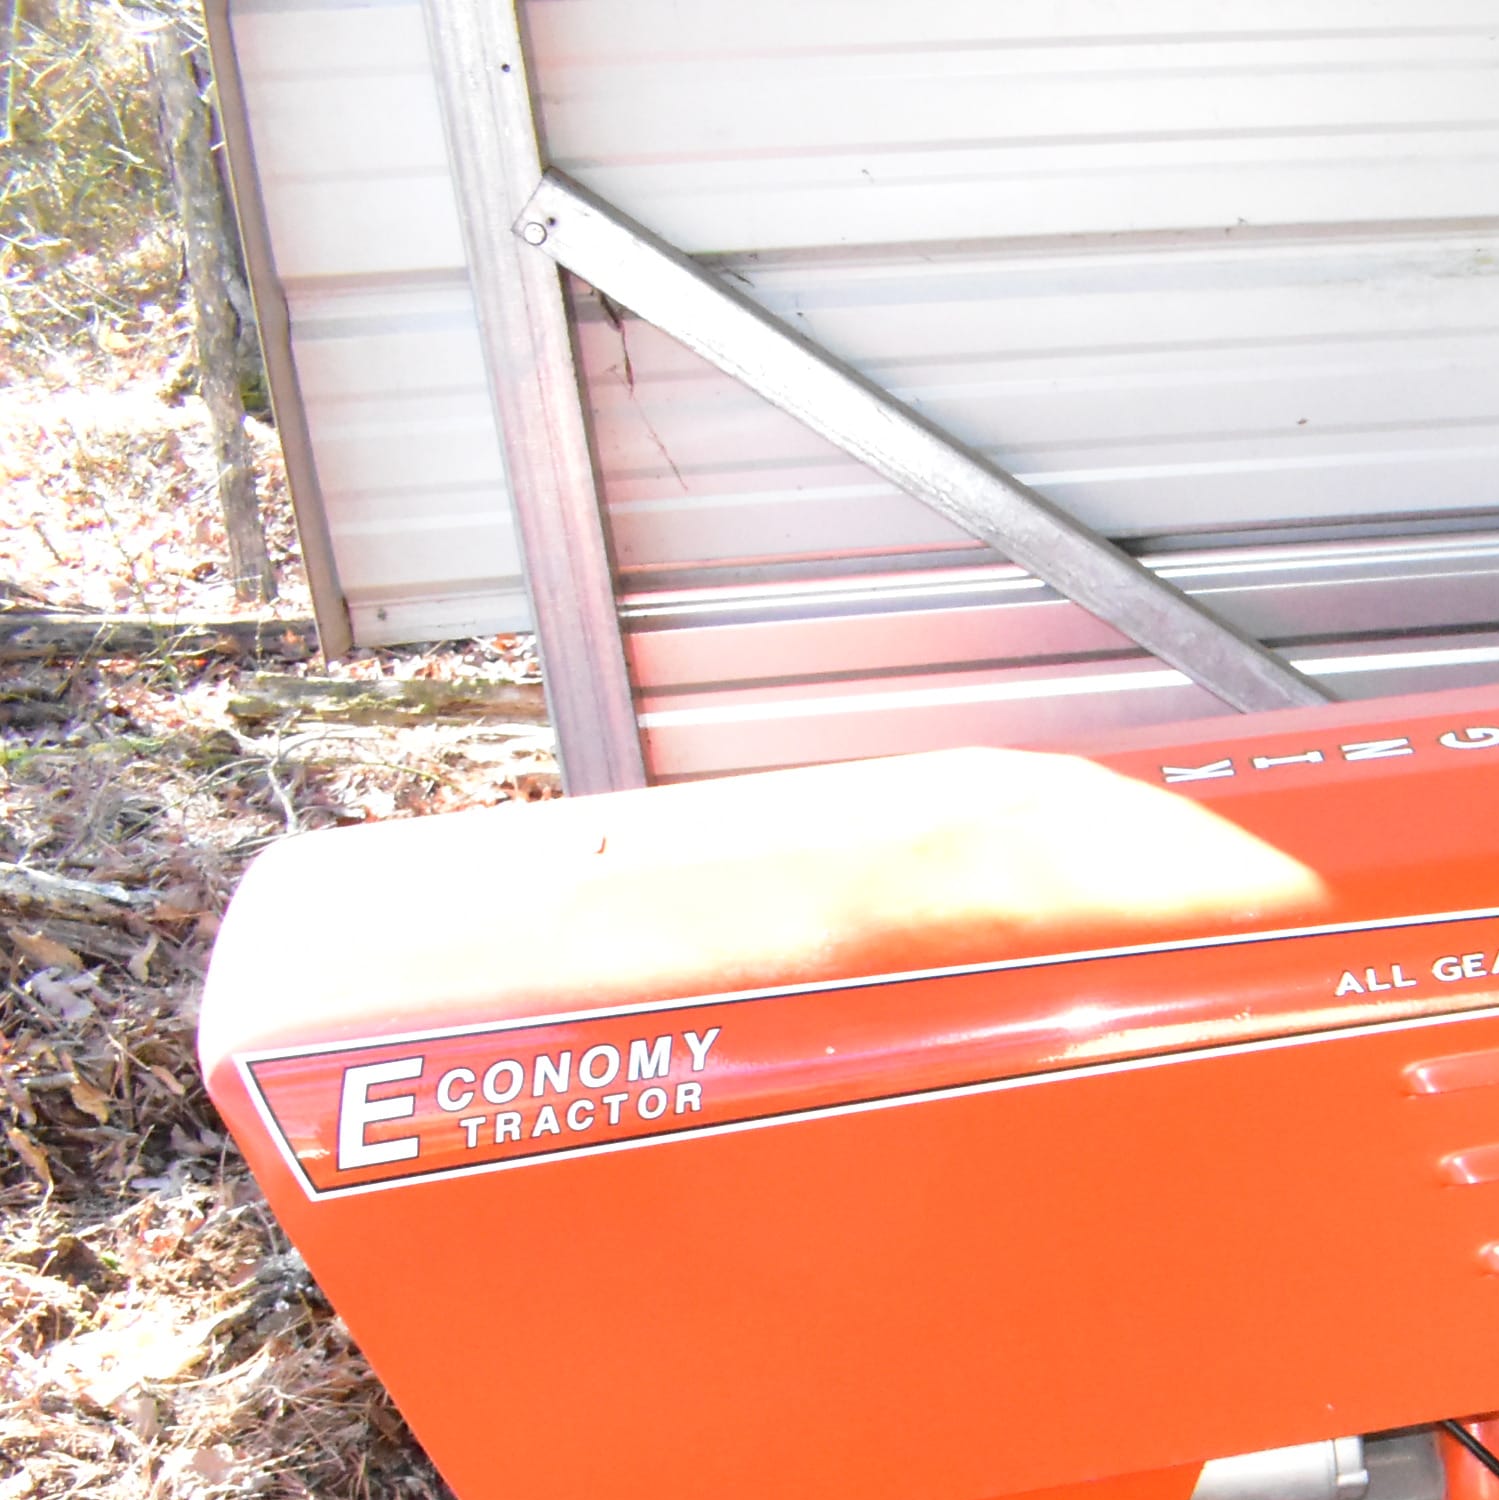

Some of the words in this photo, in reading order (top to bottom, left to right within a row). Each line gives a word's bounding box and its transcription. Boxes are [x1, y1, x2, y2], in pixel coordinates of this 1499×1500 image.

[1334, 963, 1418, 997] ALL
[336, 1026, 722, 1172] ECONOMY
[459, 1081, 703, 1149] TRACTOR
